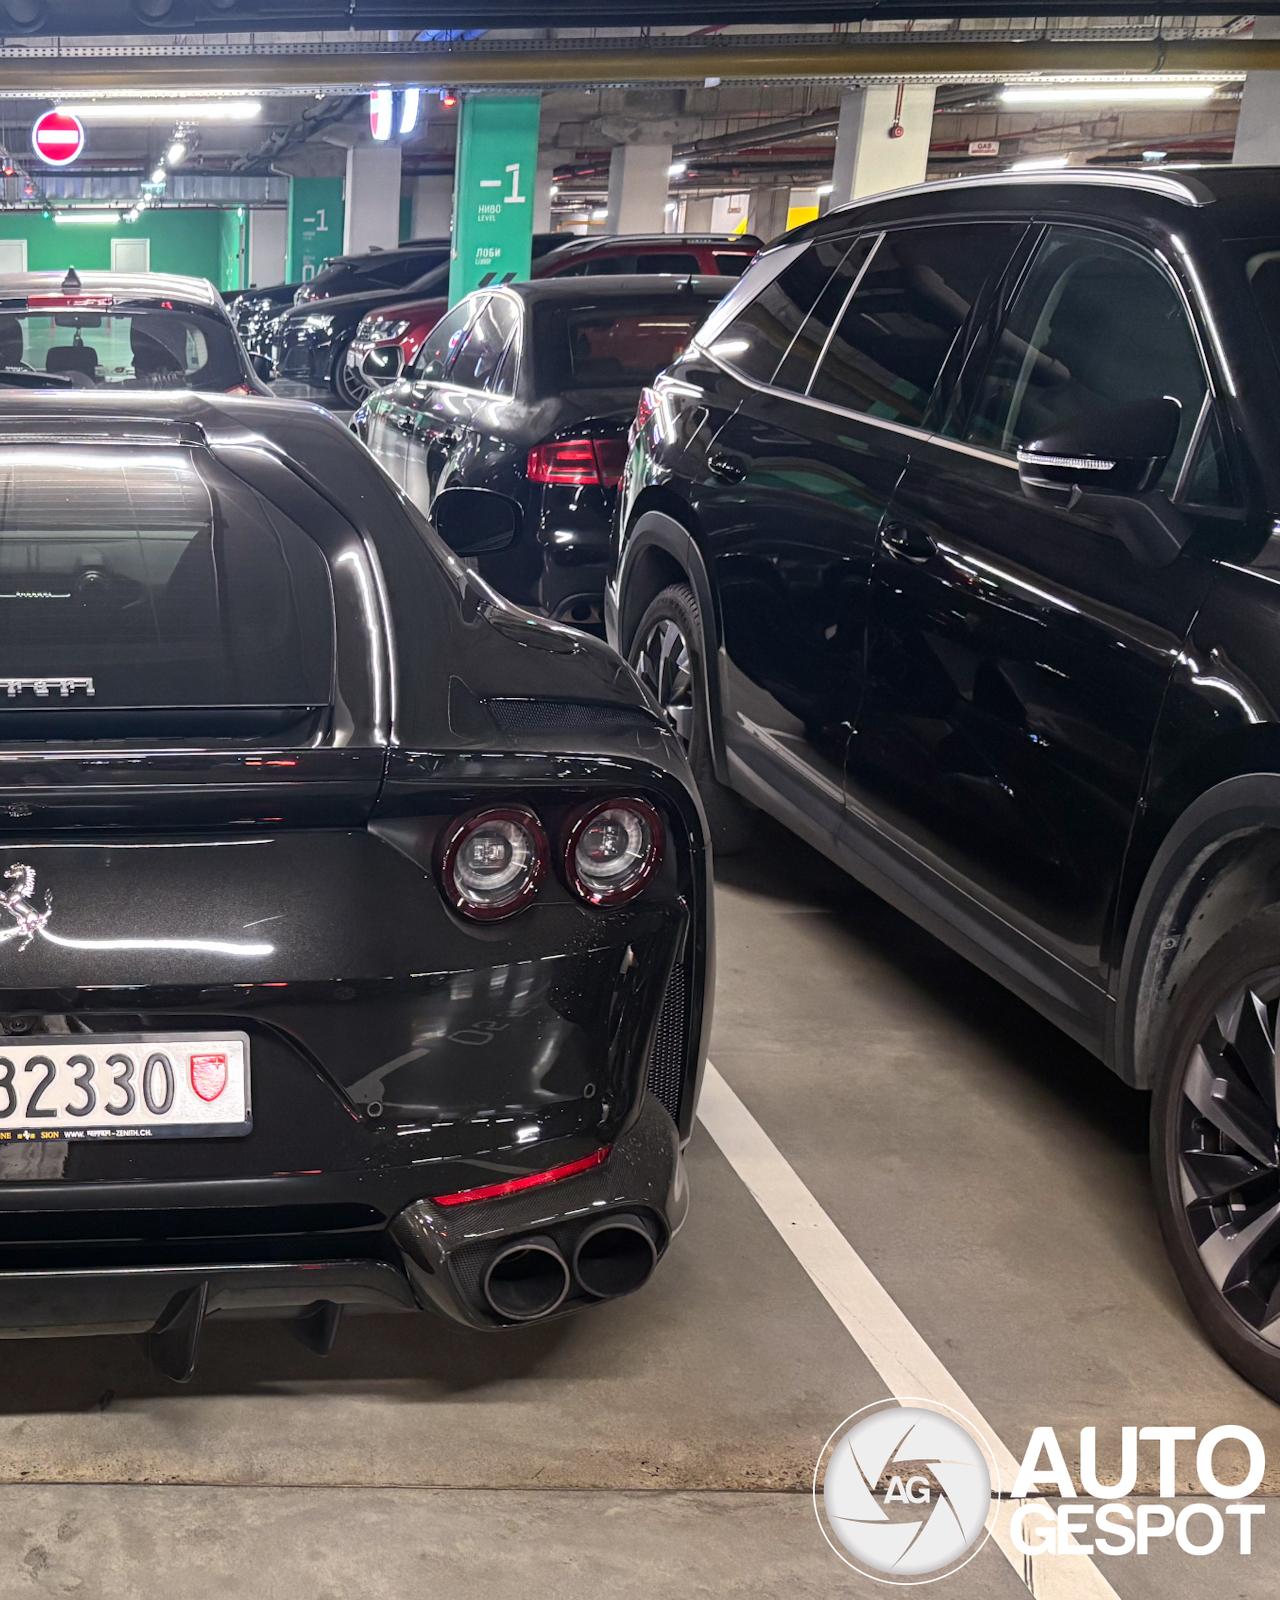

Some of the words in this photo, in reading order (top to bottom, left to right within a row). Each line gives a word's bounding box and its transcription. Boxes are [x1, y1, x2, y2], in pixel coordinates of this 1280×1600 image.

[478, 204, 501, 213] НИВО
[477, 214, 496, 222] LEVEL
[476, 248, 501, 257] ЛОБИ
[40, 1131, 60, 1139] SION
